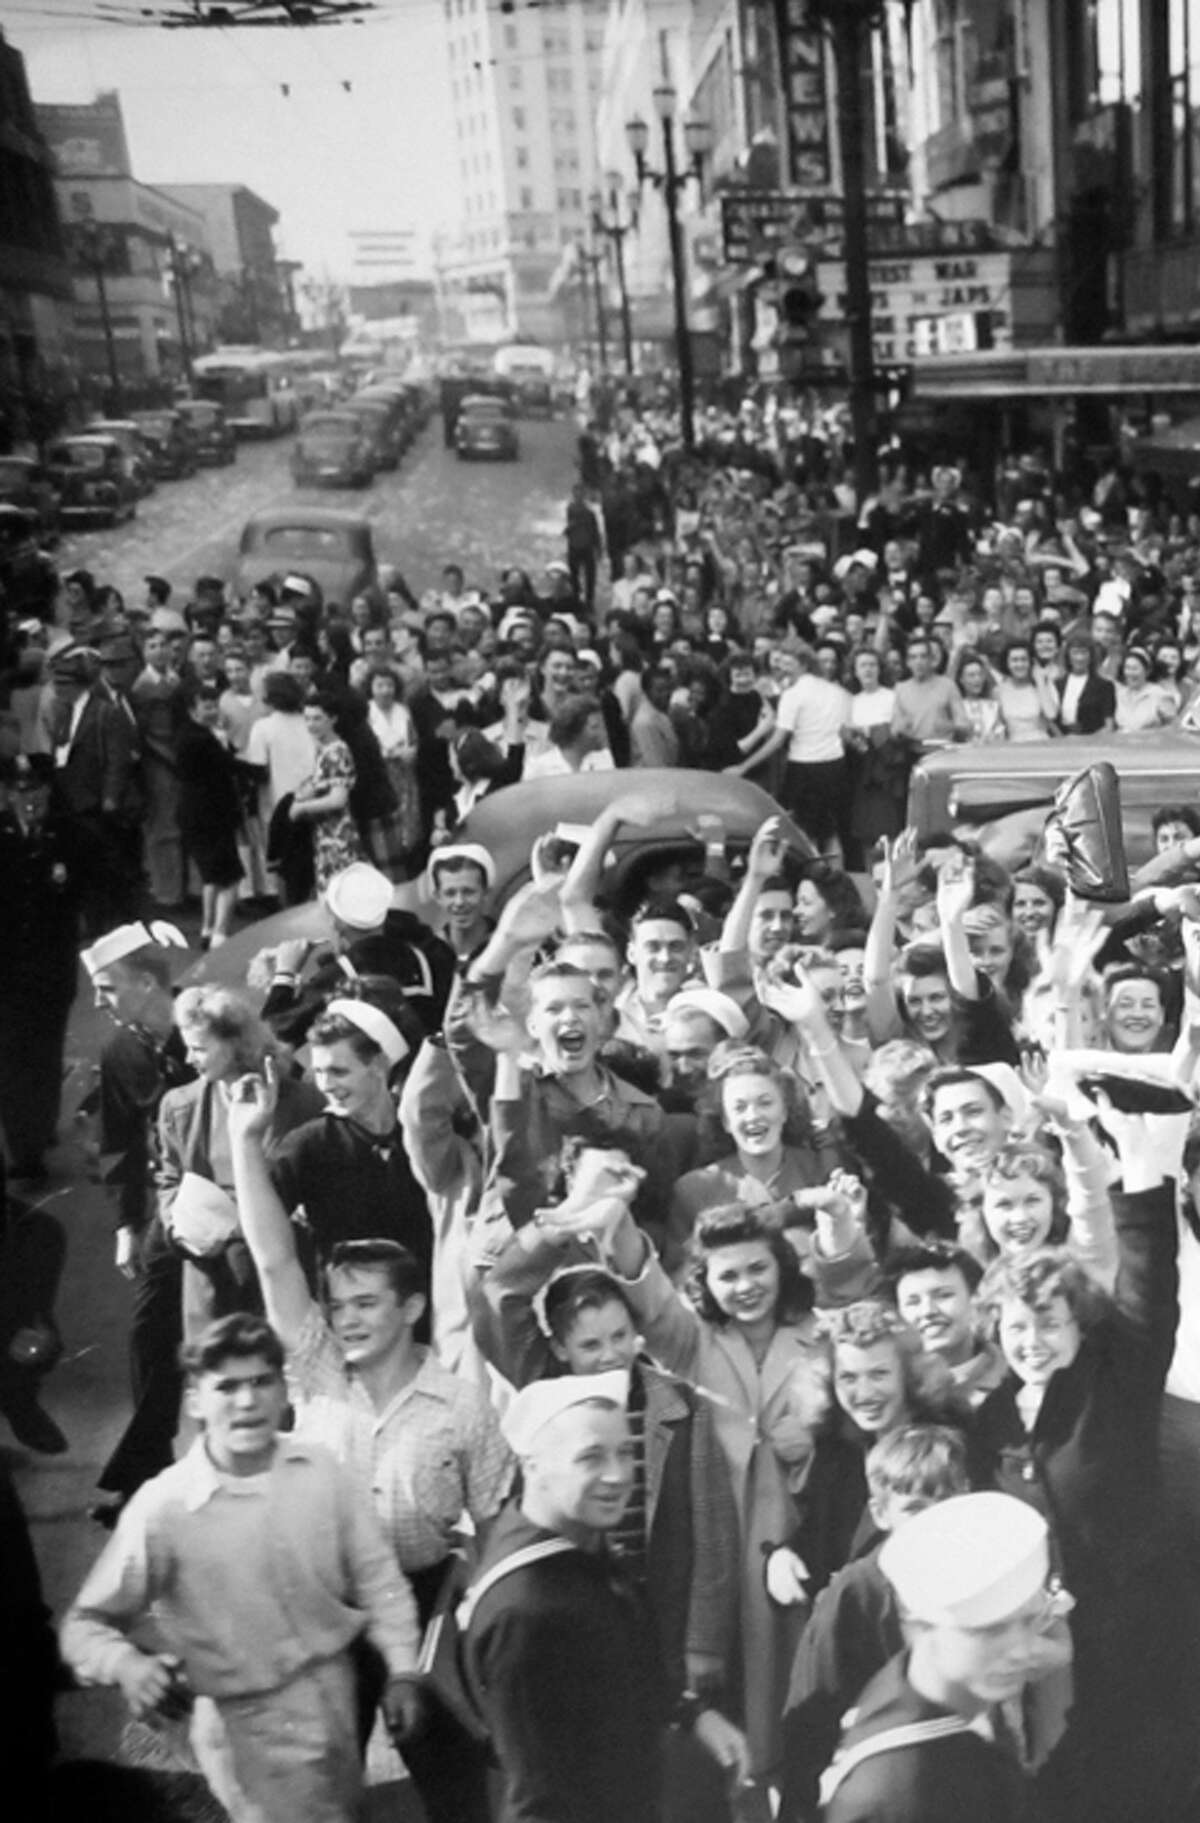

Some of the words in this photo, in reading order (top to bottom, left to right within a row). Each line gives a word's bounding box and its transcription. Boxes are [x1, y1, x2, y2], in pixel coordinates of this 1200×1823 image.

[868, 264, 912, 283] TEST
[934, 260, 978, 280] WAR
[940, 285, 990, 306] JAPS
